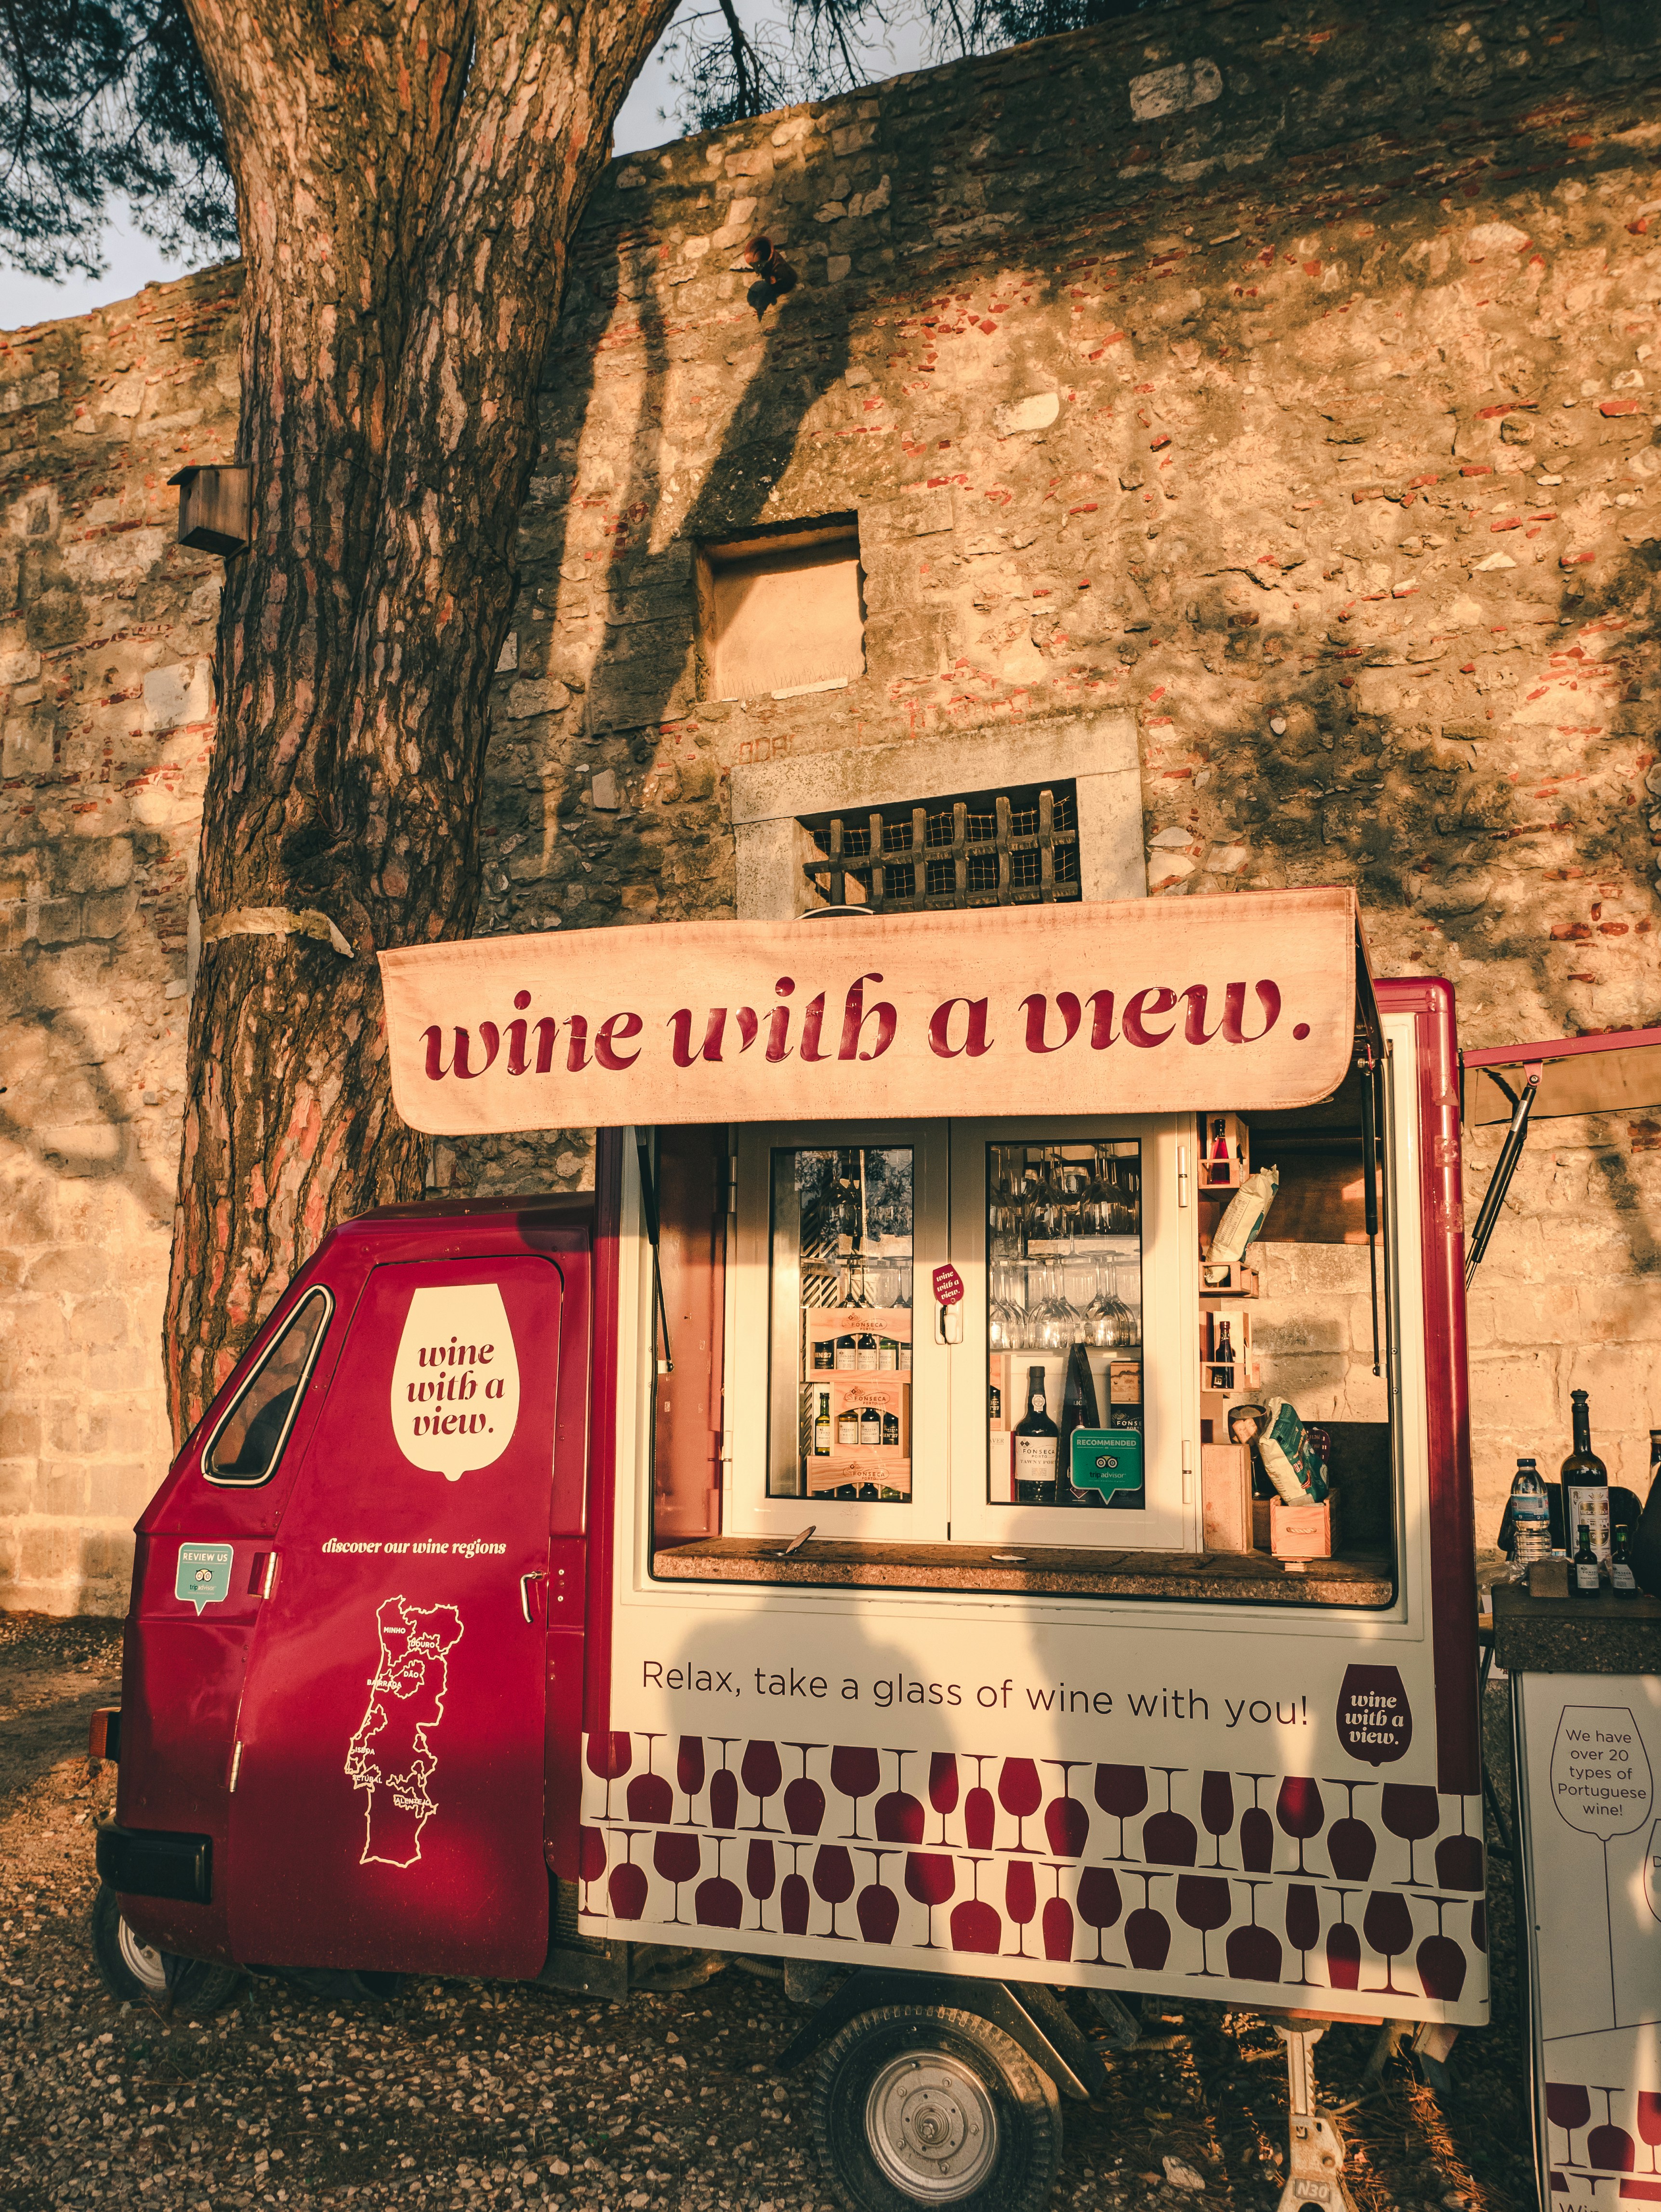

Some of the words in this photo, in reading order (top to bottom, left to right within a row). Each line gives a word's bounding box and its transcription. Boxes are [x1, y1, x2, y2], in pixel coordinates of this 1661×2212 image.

[421, 988, 642, 1081] wine
[667, 971, 898, 1066] with
[927, 996, 994, 1059] a
[1018, 977, 1312, 1055] view.
[936, 1271, 954, 1282] wine
[937, 1280, 953, 1292] with
[941, 1289, 960, 1300] view.
[417, 1336, 494, 1367] wine
[406, 1370, 478, 1403] with
[485, 1378, 505, 1399] a
[412, 1405, 494, 1436] view.
[1090, 1471, 1125, 1479] tripadvisor
[322, 1538, 382, 1553] discover
[383, 1541, 410, 1554] our
[412, 1538, 449, 1554] wine
[452, 1538, 507, 1559] regions
[183, 1553, 214, 1561] REVIEW
[217, 1554, 228, 1562] US
[403, 1670, 419, 1678] DÃO
[367, 1679, 402, 1688] BAIRRADA
[644, 1660, 741, 1698] Relax,
[754, 1667, 828, 1698] take
[841, 1678, 858, 1699] a
[873, 1673, 962, 1708] glass
[976, 1679, 1013, 1708] of
[1026, 1682, 1113, 1714] wine
[1127, 1687, 1209, 1720] with
[1224, 1695, 1307, 1728] you!
[1350, 1691, 1397, 1708] wine
[1345, 1709, 1387, 1726] with
[1392, 1715, 1404, 1727] a
[1349, 1726, 1399, 1745] view.
[1566, 1729, 1591, 1742] We
[1596, 1730, 1632, 1743] have
[1570, 1750, 1604, 1760] over
[1609, 1749, 1629, 1762] 20
[1569, 1766, 1611, 1780] types
[1617, 1768, 1633, 1780] of
[1558, 1783, 1647, 1799] Portuguese
[1583, 1803, 1623, 1816] wine!
